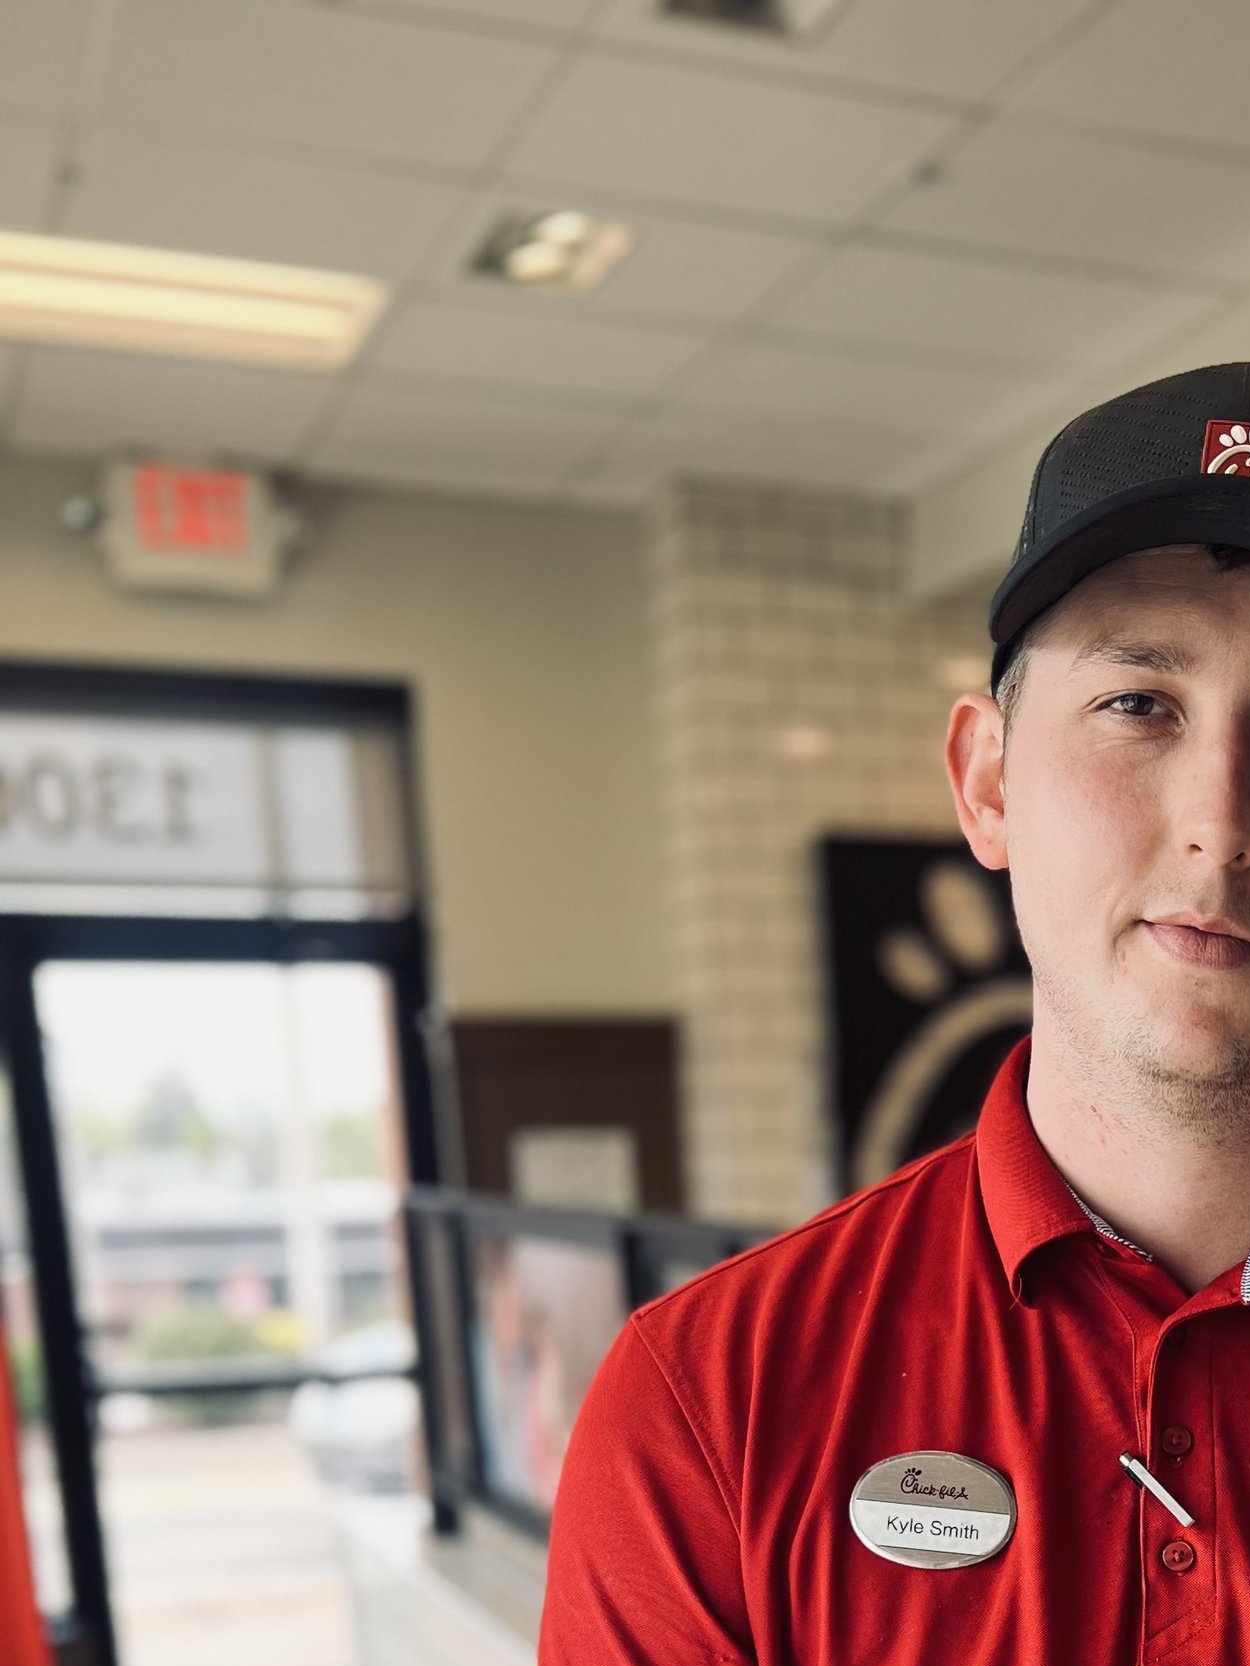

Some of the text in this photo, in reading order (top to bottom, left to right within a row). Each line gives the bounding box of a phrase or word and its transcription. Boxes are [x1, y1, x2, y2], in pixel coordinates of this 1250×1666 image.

[900, 1469, 969, 1500] Chick-fil-A
[886, 1515, 979, 1540] Kyle Smith
